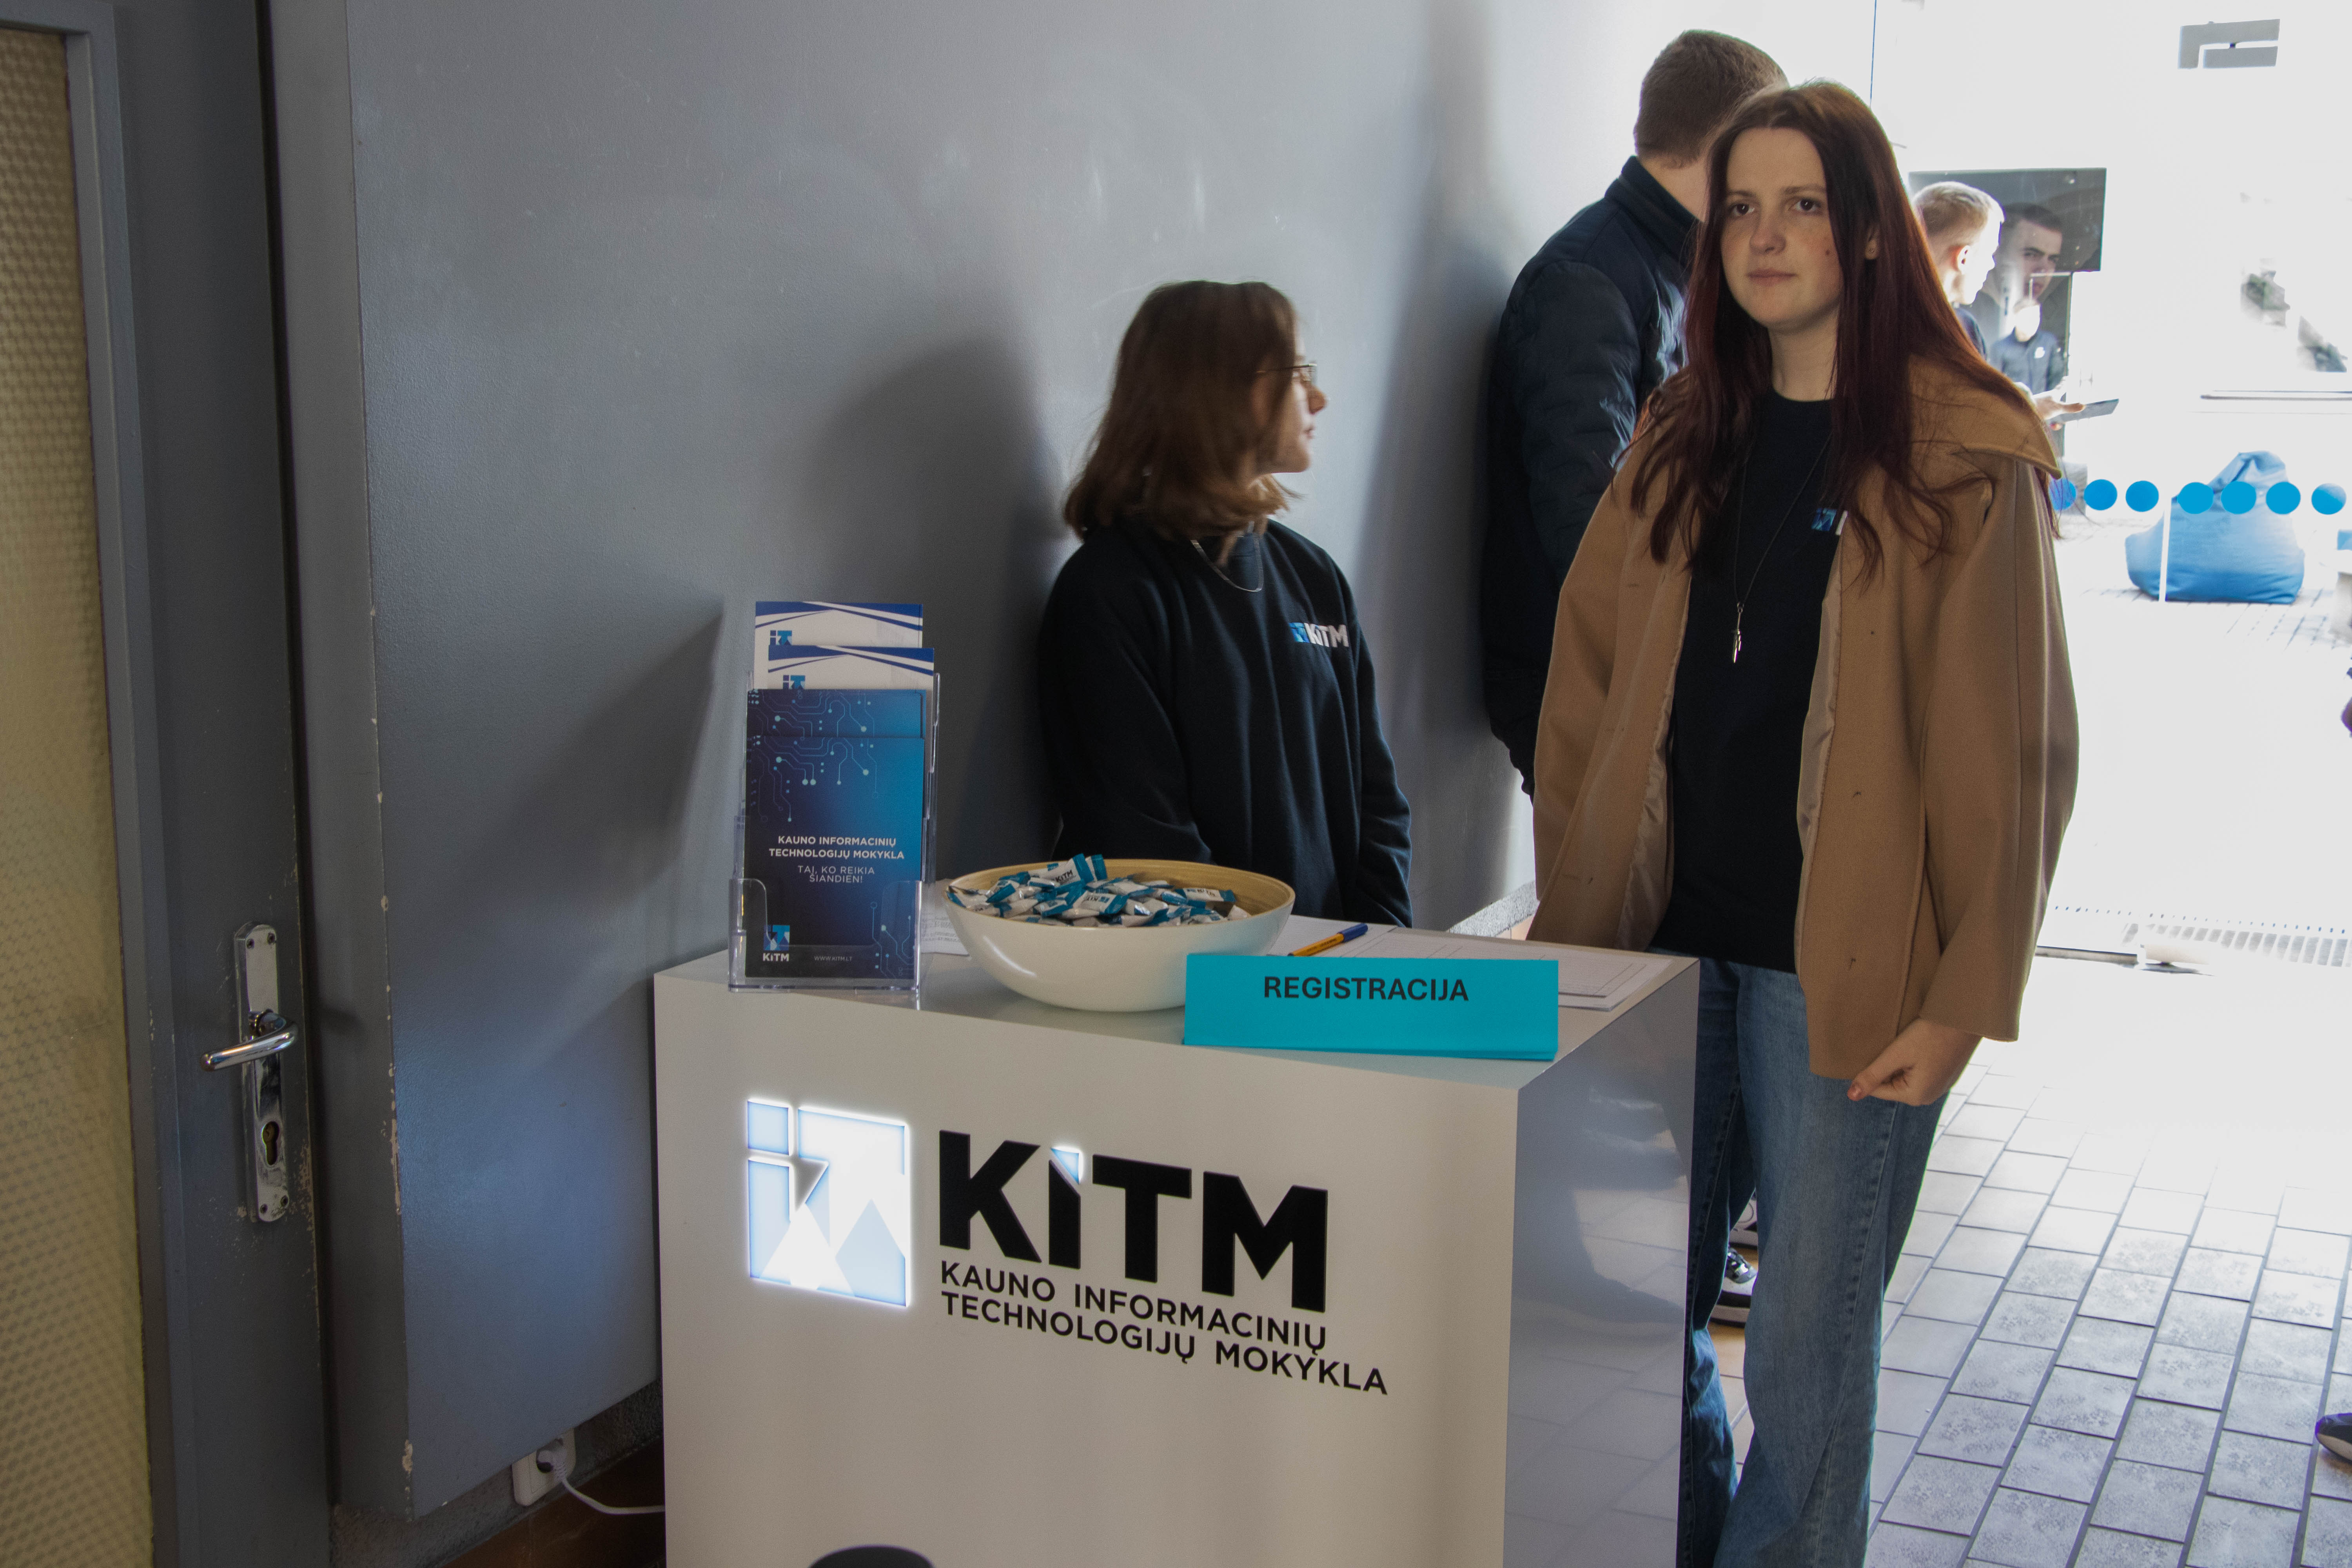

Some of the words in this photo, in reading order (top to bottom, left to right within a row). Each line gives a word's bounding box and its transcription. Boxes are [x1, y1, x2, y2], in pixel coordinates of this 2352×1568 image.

[778, 835, 815, 845] KAUNO
[819, 837, 896, 847] INFORMACINIŲ
[769, 849, 849, 859] TECHNOLOGIJŲ
[853, 850, 904, 859] MOKYKLA
[840, 866, 875, 875] REIKIA
[1264, 976, 1469, 1001] REGISTRACIJA
[941, 1260, 1055, 1302] KAUNO
[1075, 1284, 1326, 1354] INFORMACINIŲ
[941, 1291, 1195, 1363] TECHNOLOGIJŲ
[1216, 1340, 1388, 1395] MOKYKLA
